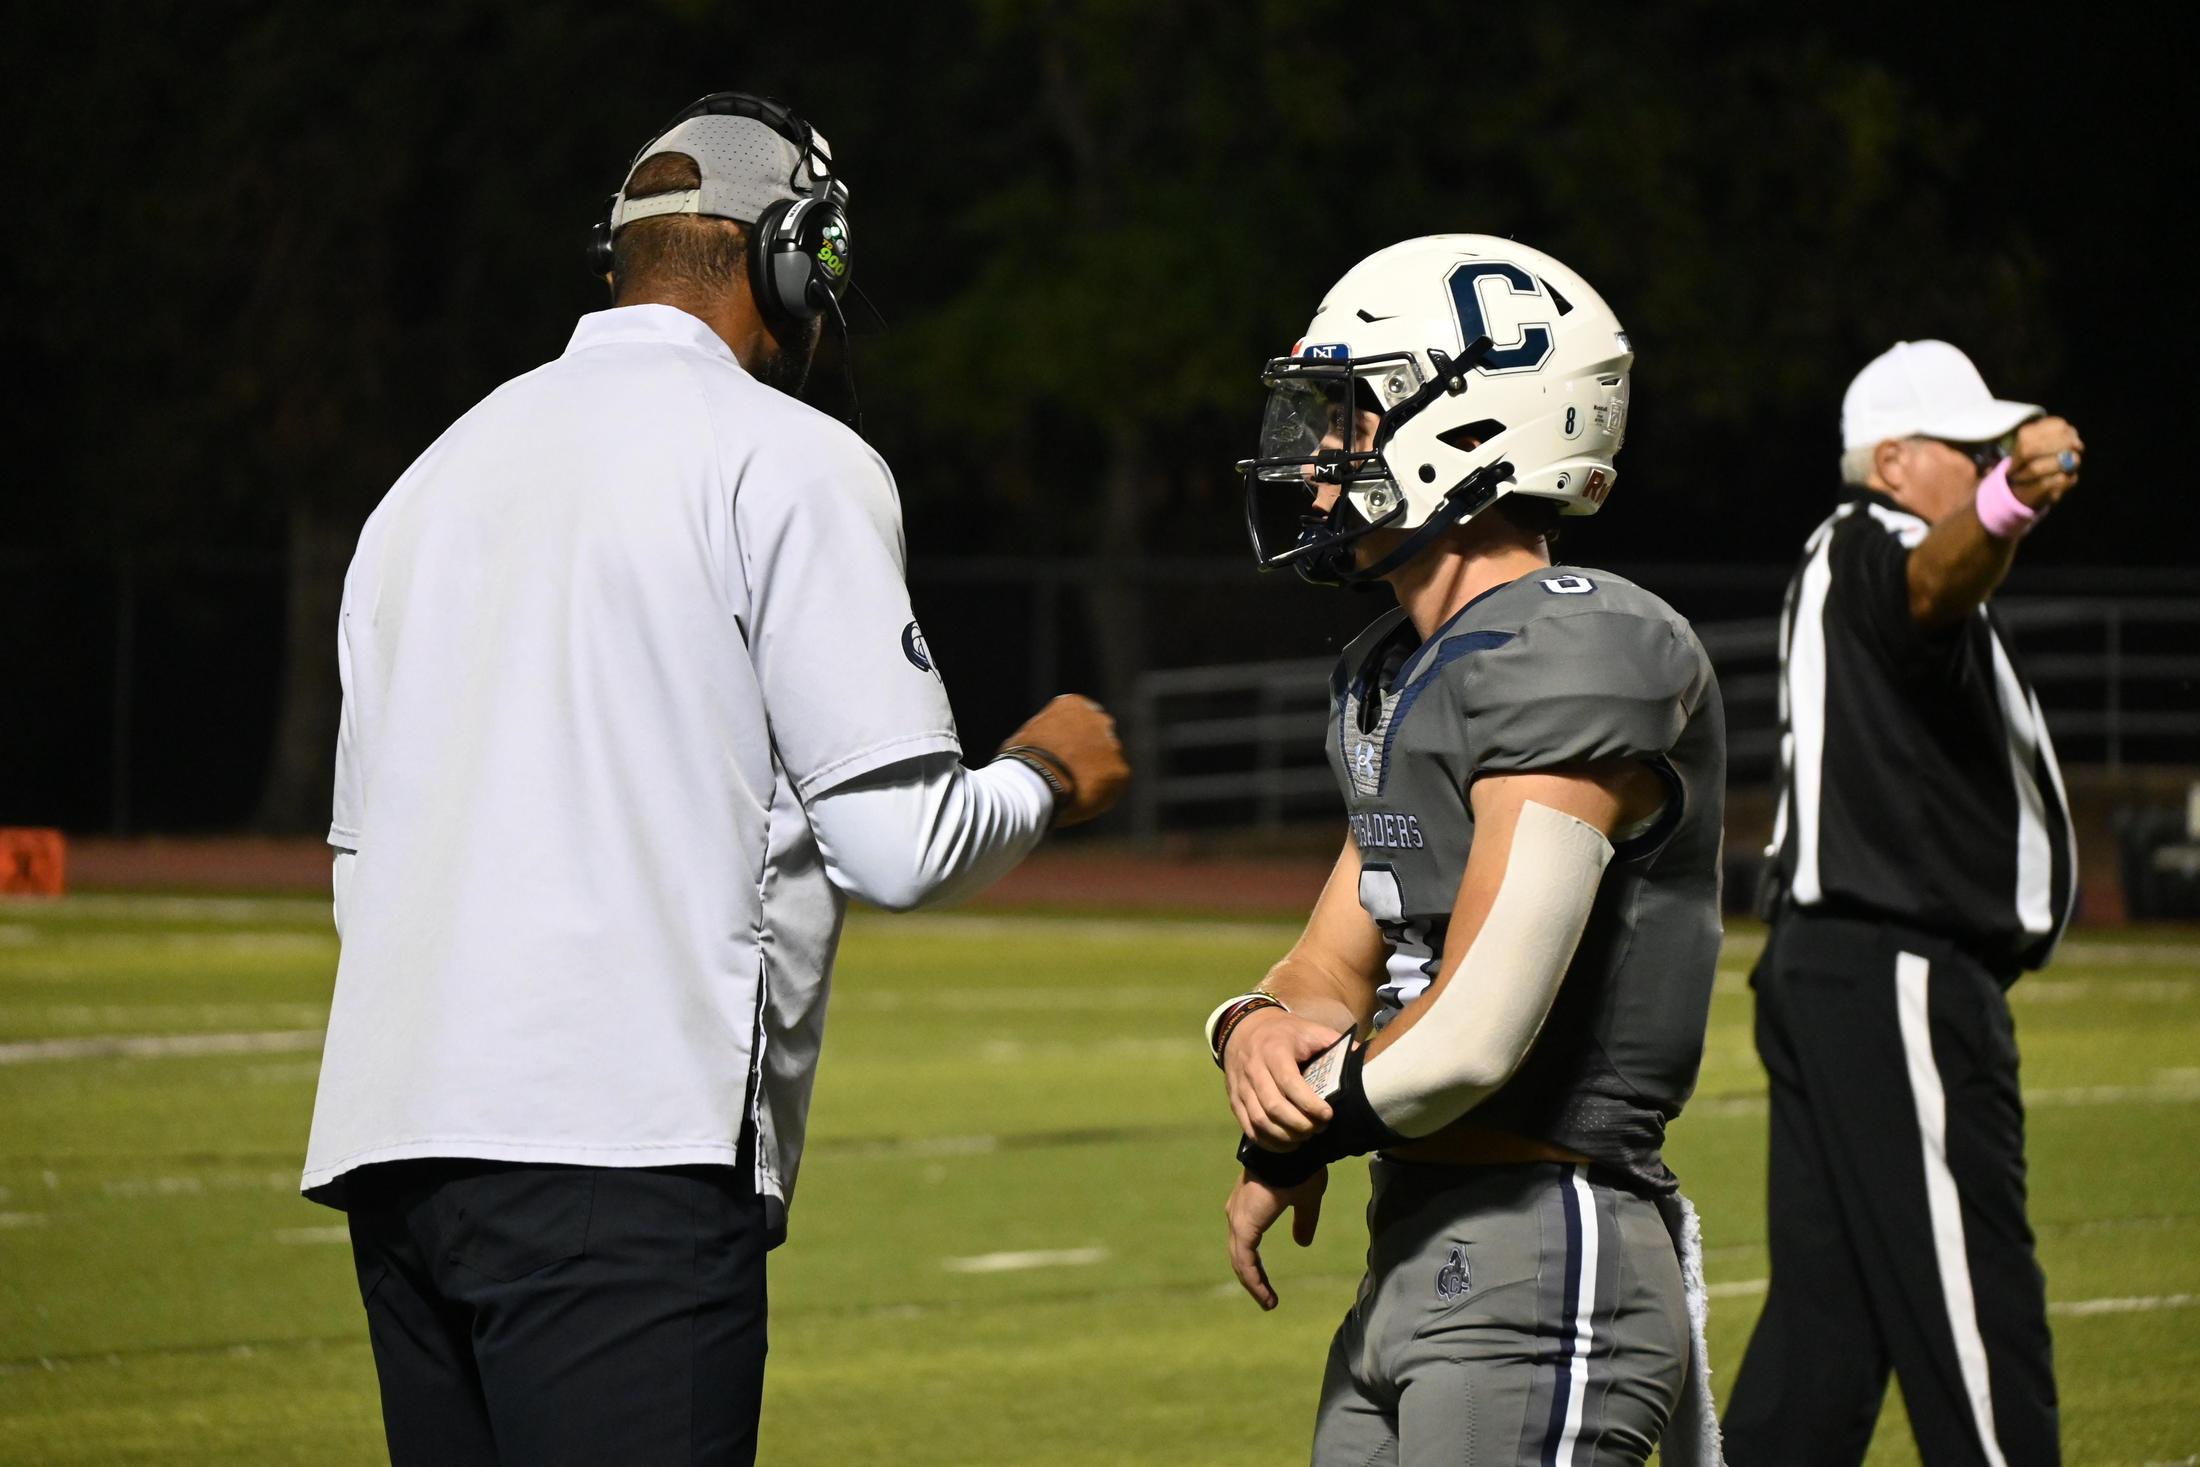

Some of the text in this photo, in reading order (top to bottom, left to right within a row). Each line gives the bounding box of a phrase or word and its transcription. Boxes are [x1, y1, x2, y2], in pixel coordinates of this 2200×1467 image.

[817, 247, 845, 277] 900
[1444, 261, 1555, 377] C
[1565, 406, 1576, 435] 8
